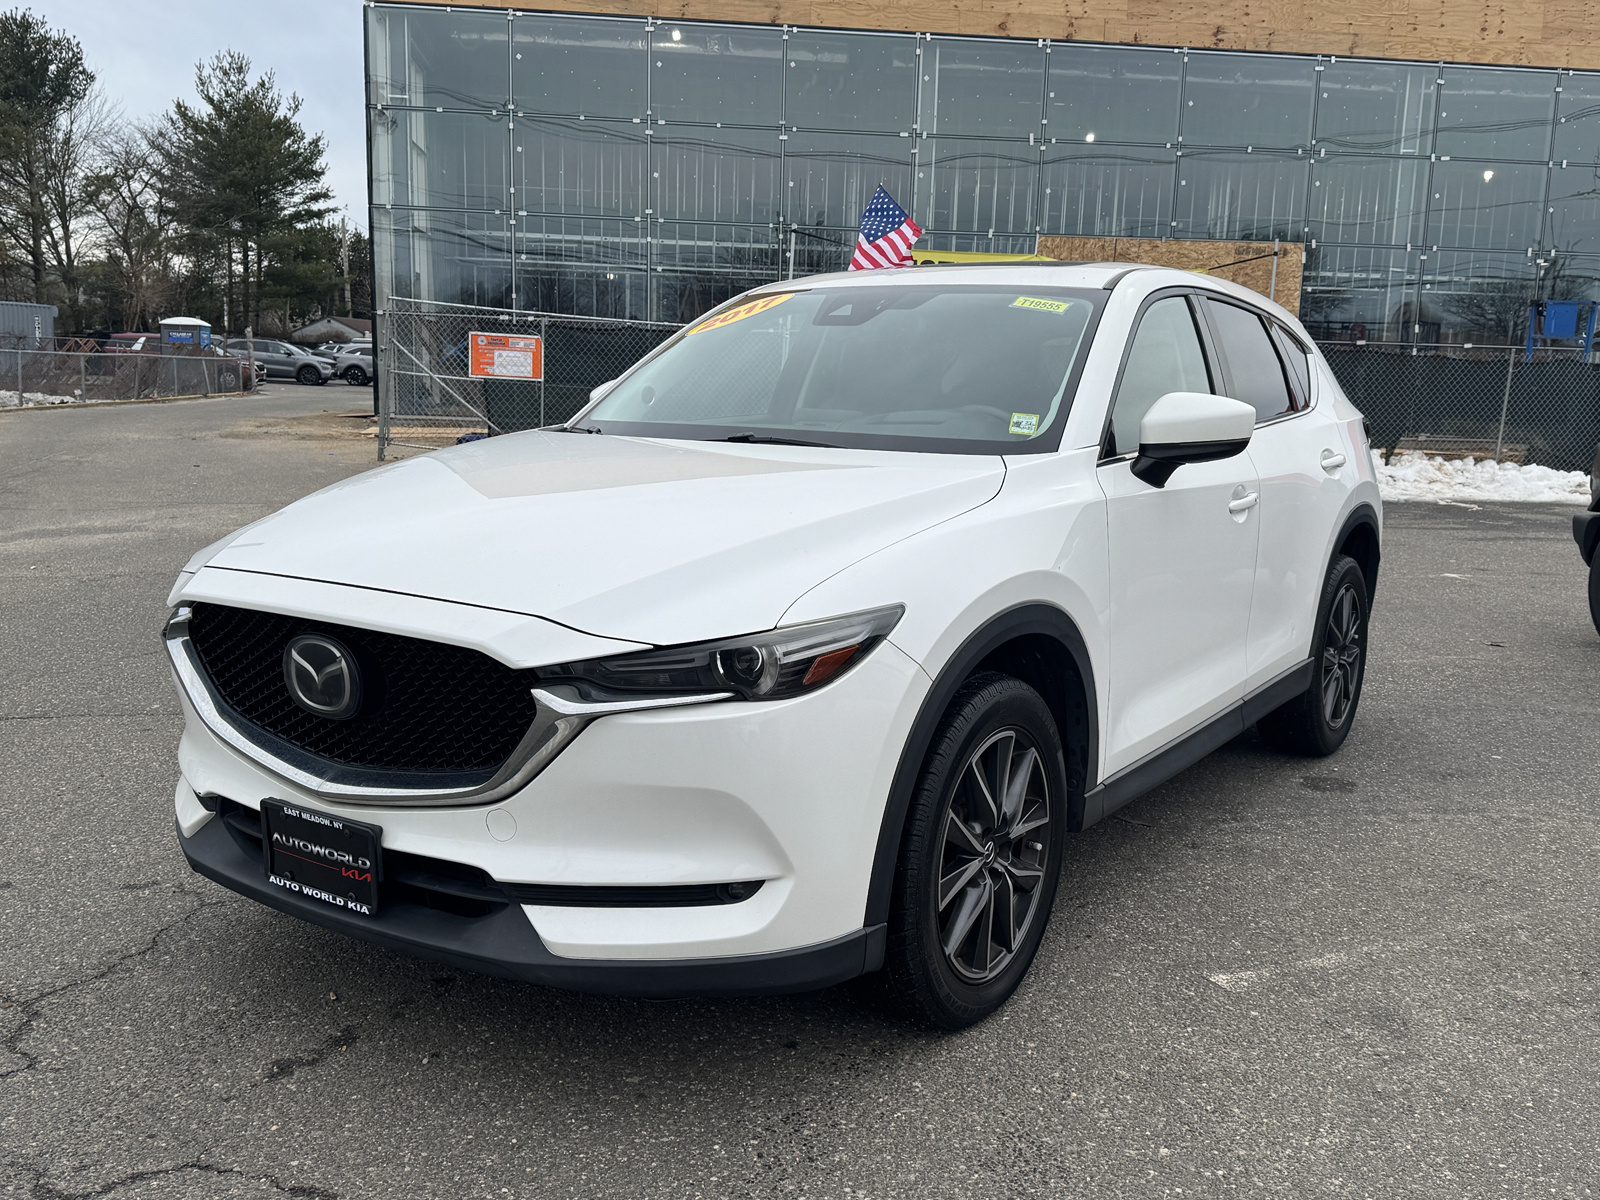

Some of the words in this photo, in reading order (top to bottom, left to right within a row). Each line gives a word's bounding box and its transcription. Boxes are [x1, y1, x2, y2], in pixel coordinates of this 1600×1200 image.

[696, 295, 783, 333] 2017
[1021, 299, 1062, 311] T19555
[283, 806, 300, 818] EAST
[333, 820, 343, 830] NY
[272, 832, 371, 869] AUTOWORLD
[341, 867, 372, 883] KIA
[269, 875, 299, 892] AUTO
[302, 886, 344, 906] WORLD
[347, 900, 369, 915] KIA
